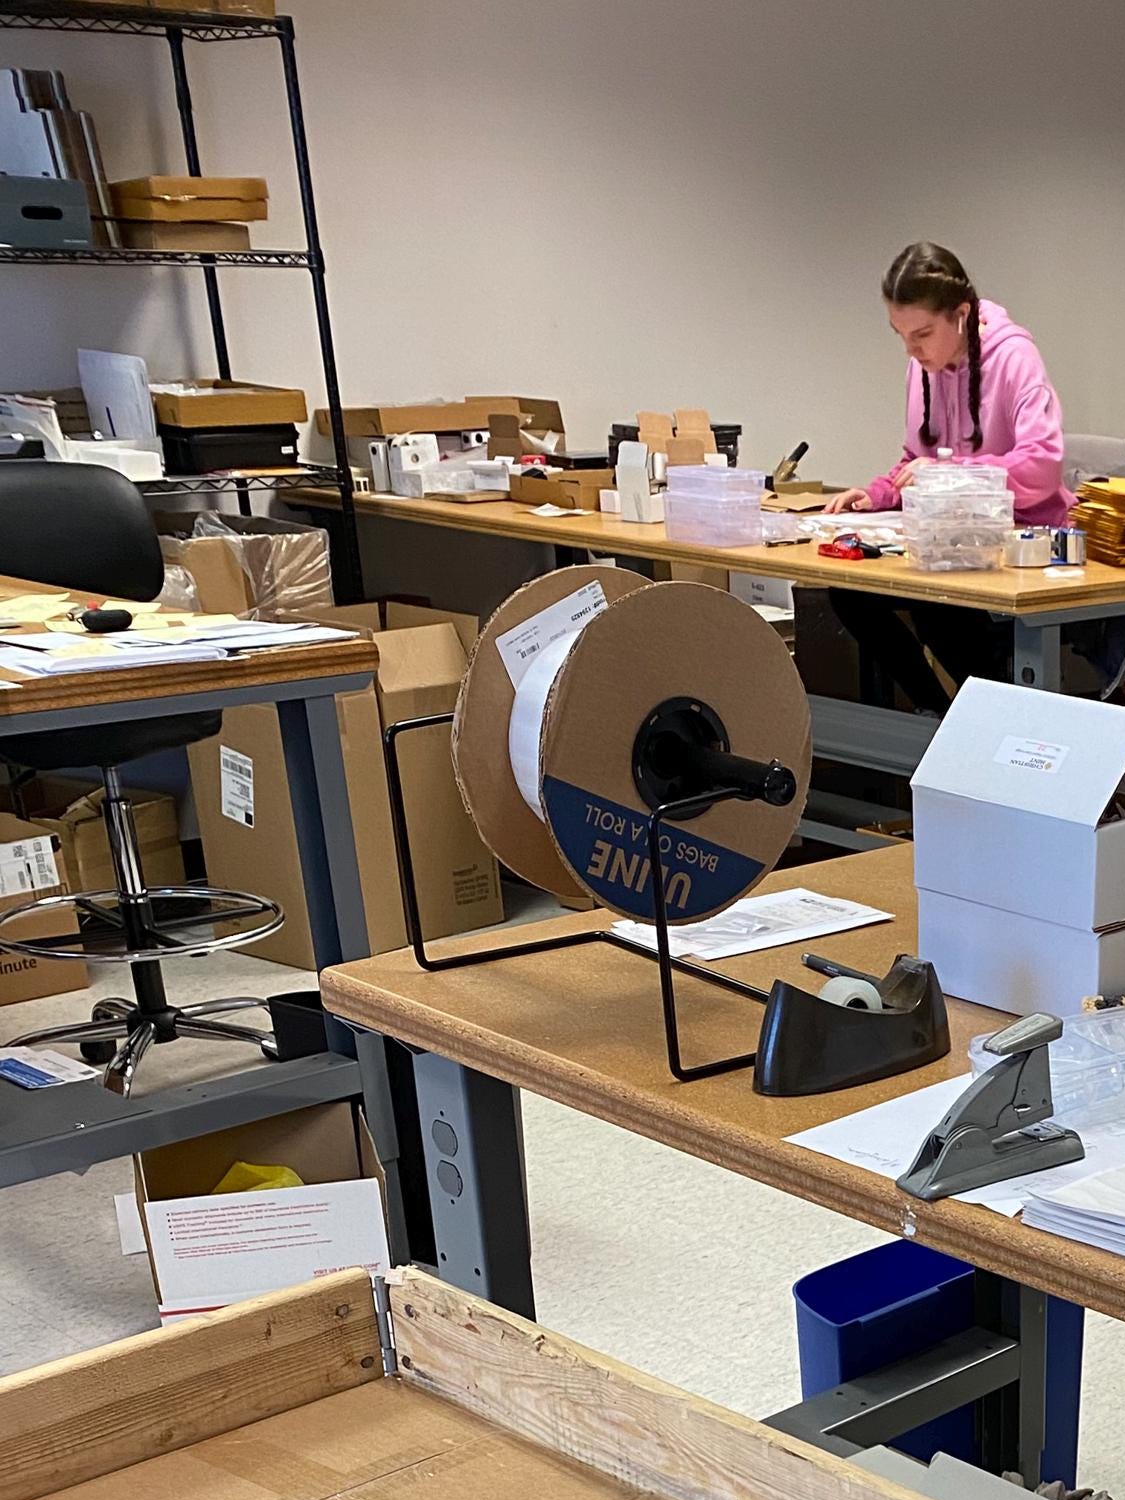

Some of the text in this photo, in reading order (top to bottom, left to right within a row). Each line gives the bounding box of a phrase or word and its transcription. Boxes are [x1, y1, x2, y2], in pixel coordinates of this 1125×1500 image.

[585, 803, 719, 873] BAGS O A ROLL
